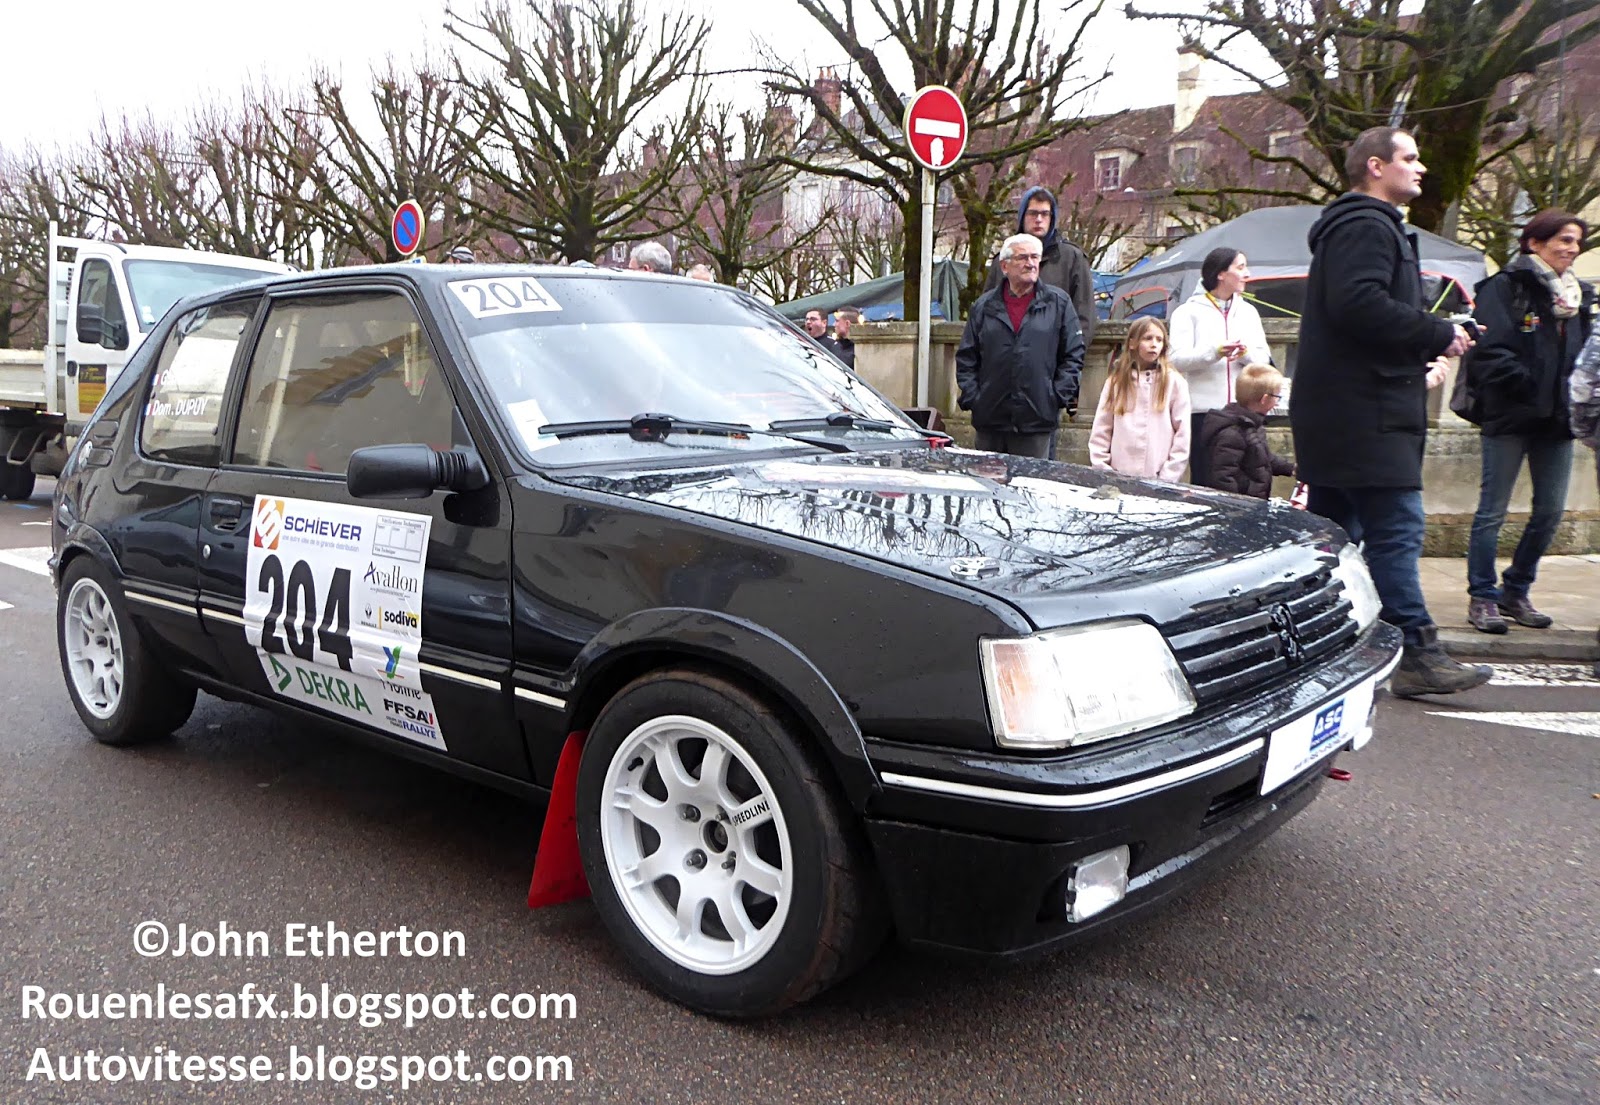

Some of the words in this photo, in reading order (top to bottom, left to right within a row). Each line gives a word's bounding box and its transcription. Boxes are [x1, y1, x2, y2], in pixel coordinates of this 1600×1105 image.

[462, 280, 548, 311] 204
[175, 397, 209, 416] DUPUY
[364, 561, 418, 593] Avallon
[258, 554, 354, 672] 204
[384, 610, 418, 629] sodiva
[295, 666, 373, 715] DEKRA
[384, 699, 430, 724] FFSA
[1314, 705, 1343, 737] ASC
[403, 721, 437, 739] RALLYE
